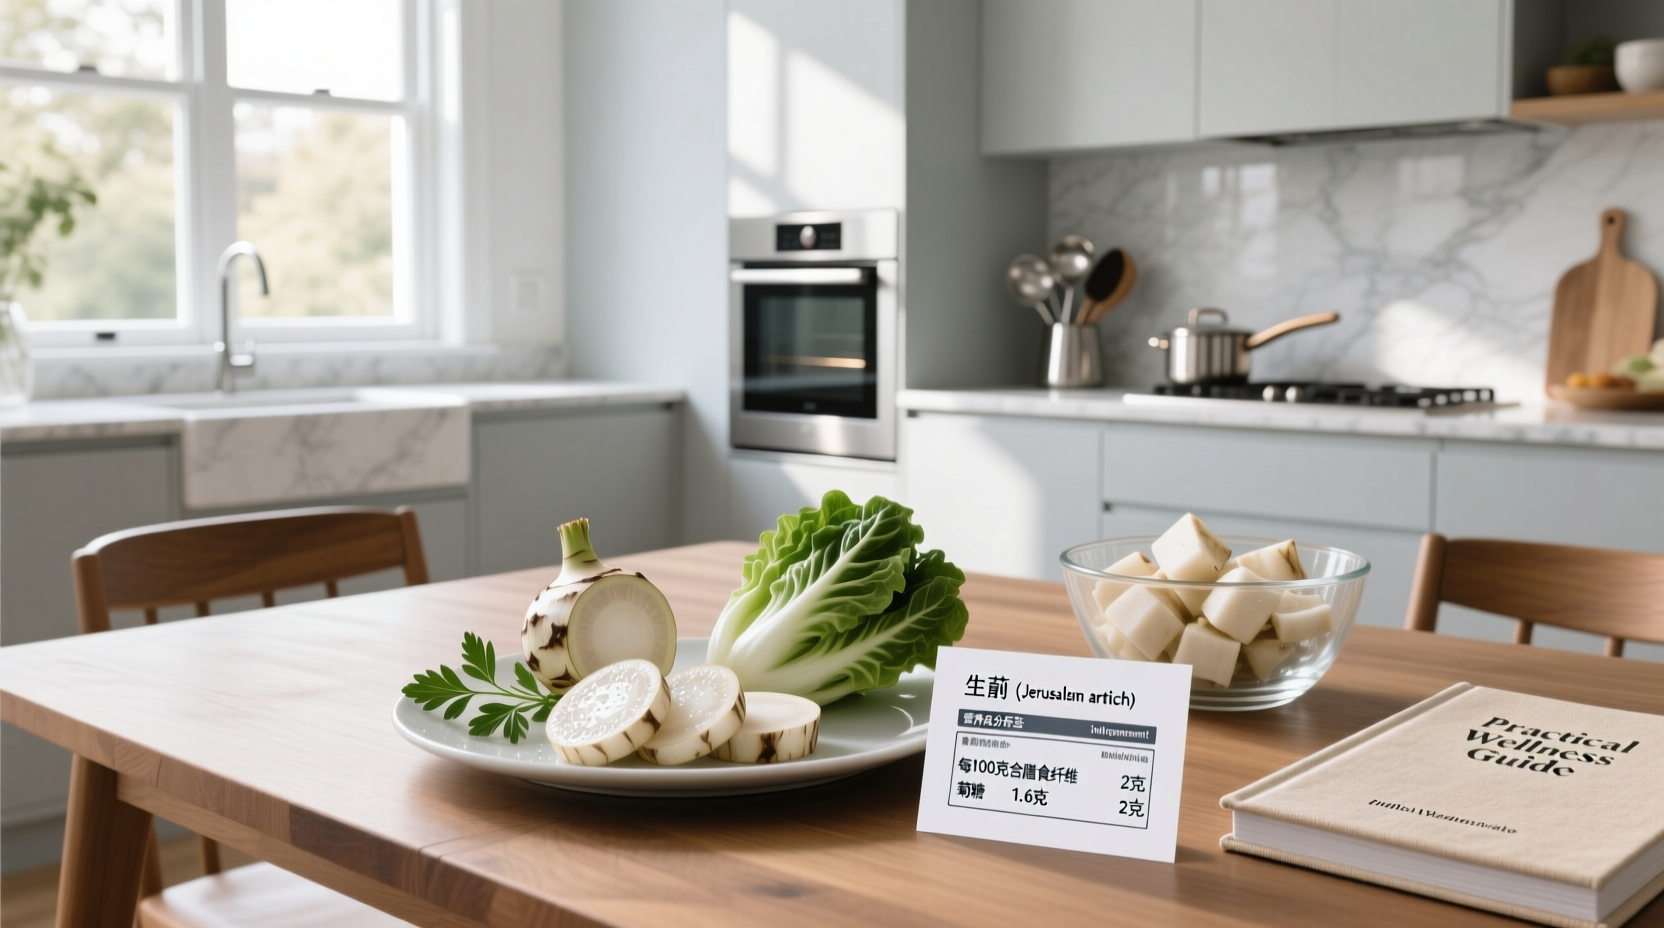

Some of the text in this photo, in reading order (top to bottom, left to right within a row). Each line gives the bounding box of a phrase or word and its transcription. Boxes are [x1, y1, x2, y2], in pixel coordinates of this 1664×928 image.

[1089, 690, 1136, 710] artich)
[1466, 729, 1615, 766] Wellness
[1482, 716, 1640, 754] Practical
[1467, 748, 1575, 777] Guide
[1120, 774, 1146, 793] 2克
[1011, 787, 1049, 806] 1.6克
[1118, 798, 1144, 818] 2克
